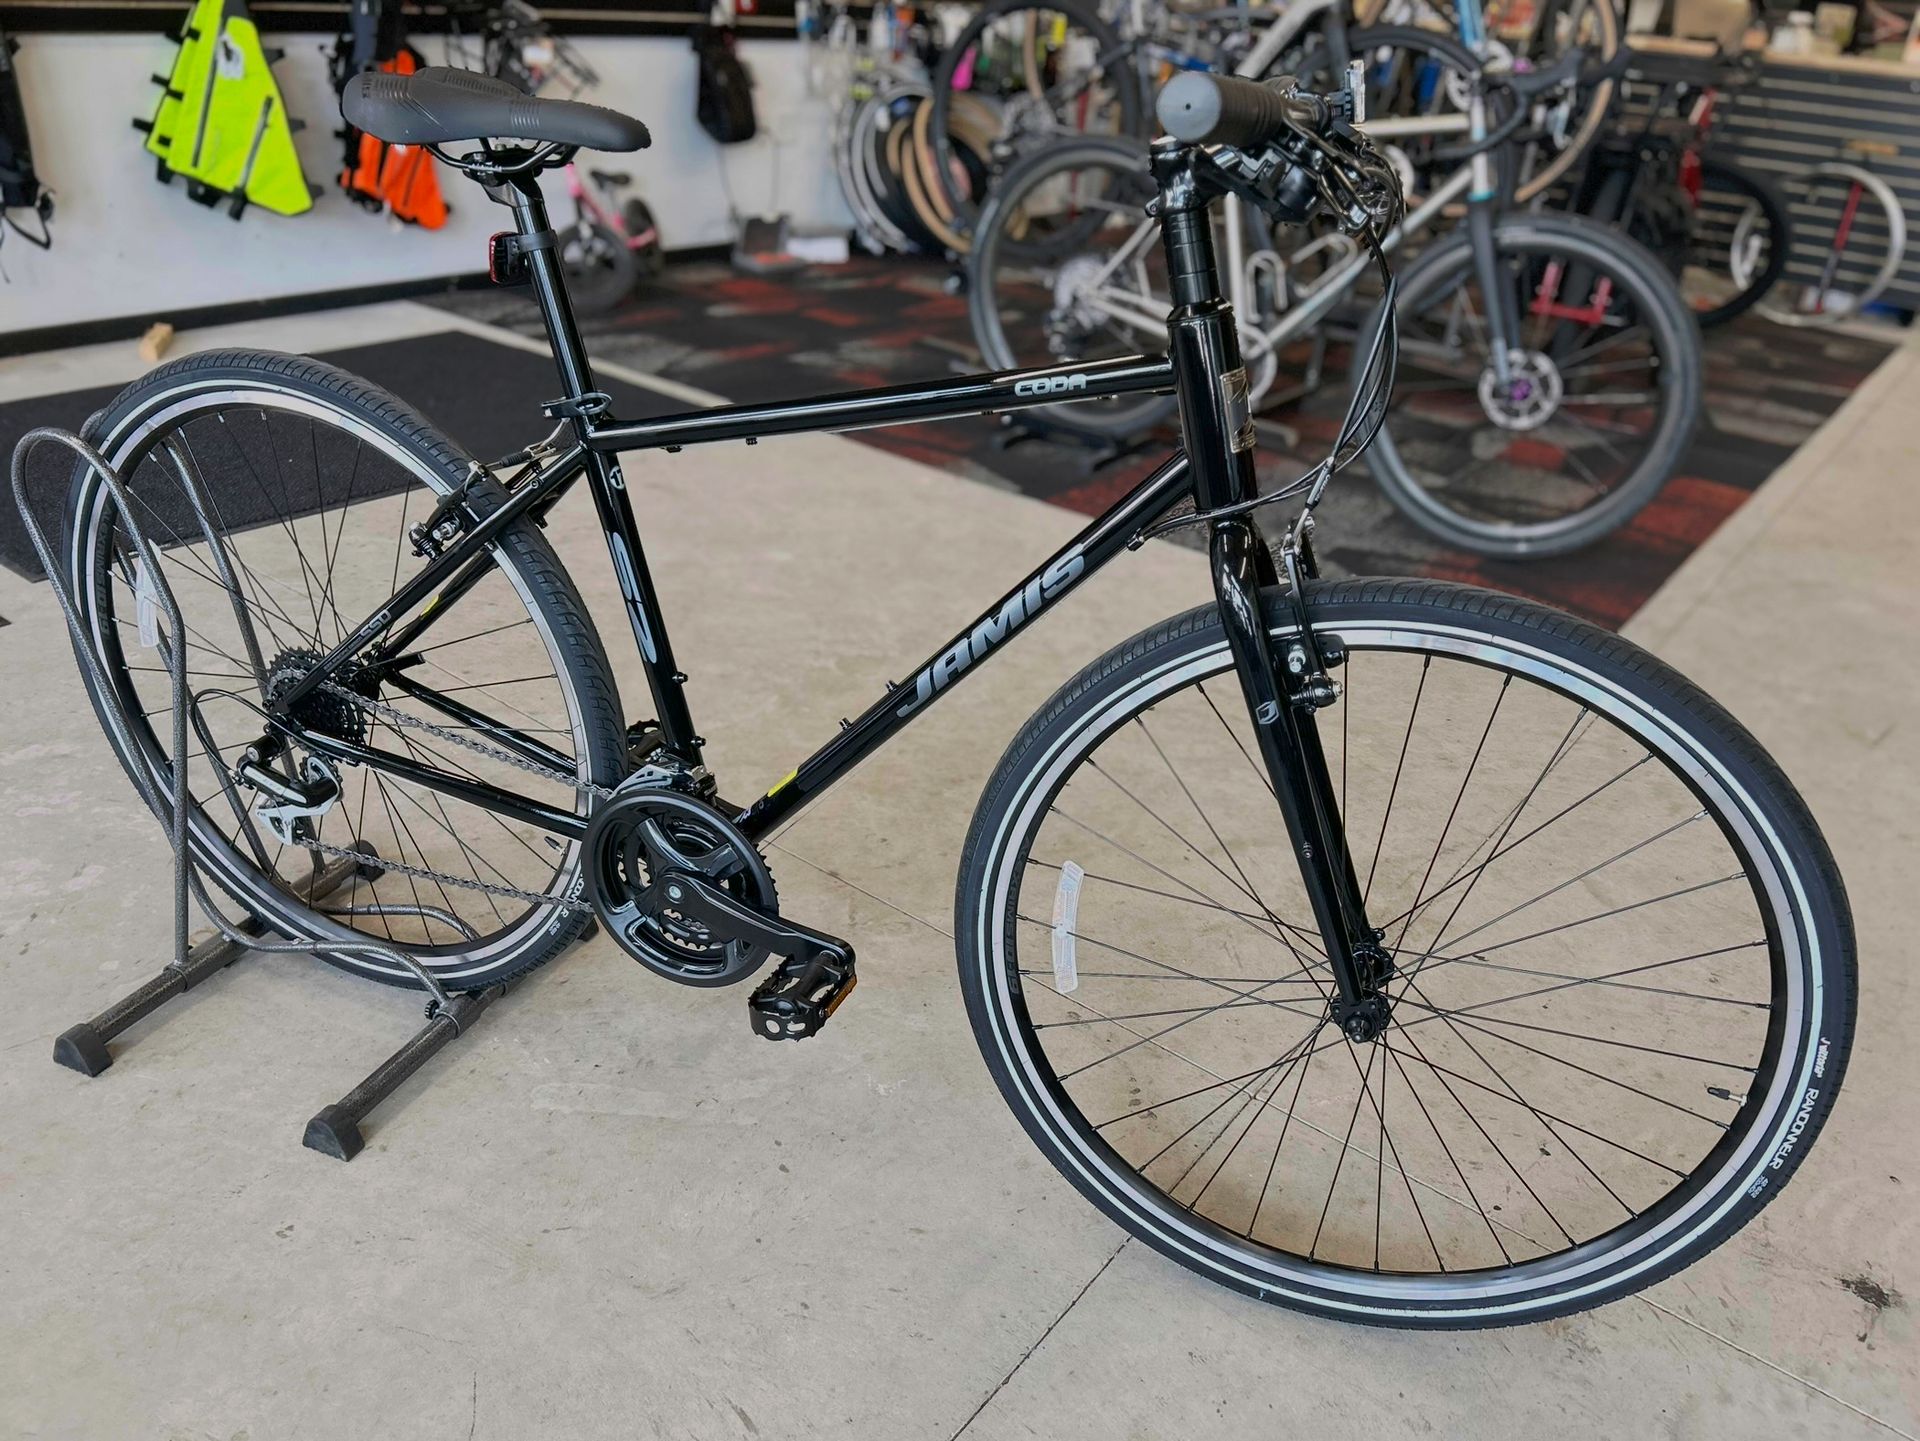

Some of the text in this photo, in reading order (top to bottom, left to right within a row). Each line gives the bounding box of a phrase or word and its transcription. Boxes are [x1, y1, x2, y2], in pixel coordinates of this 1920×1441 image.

[1015, 374, 1087, 397] CODA
[897, 543, 1085, 717] JAMIS
[1769, 1087, 1819, 1170] RANDONNEUR
